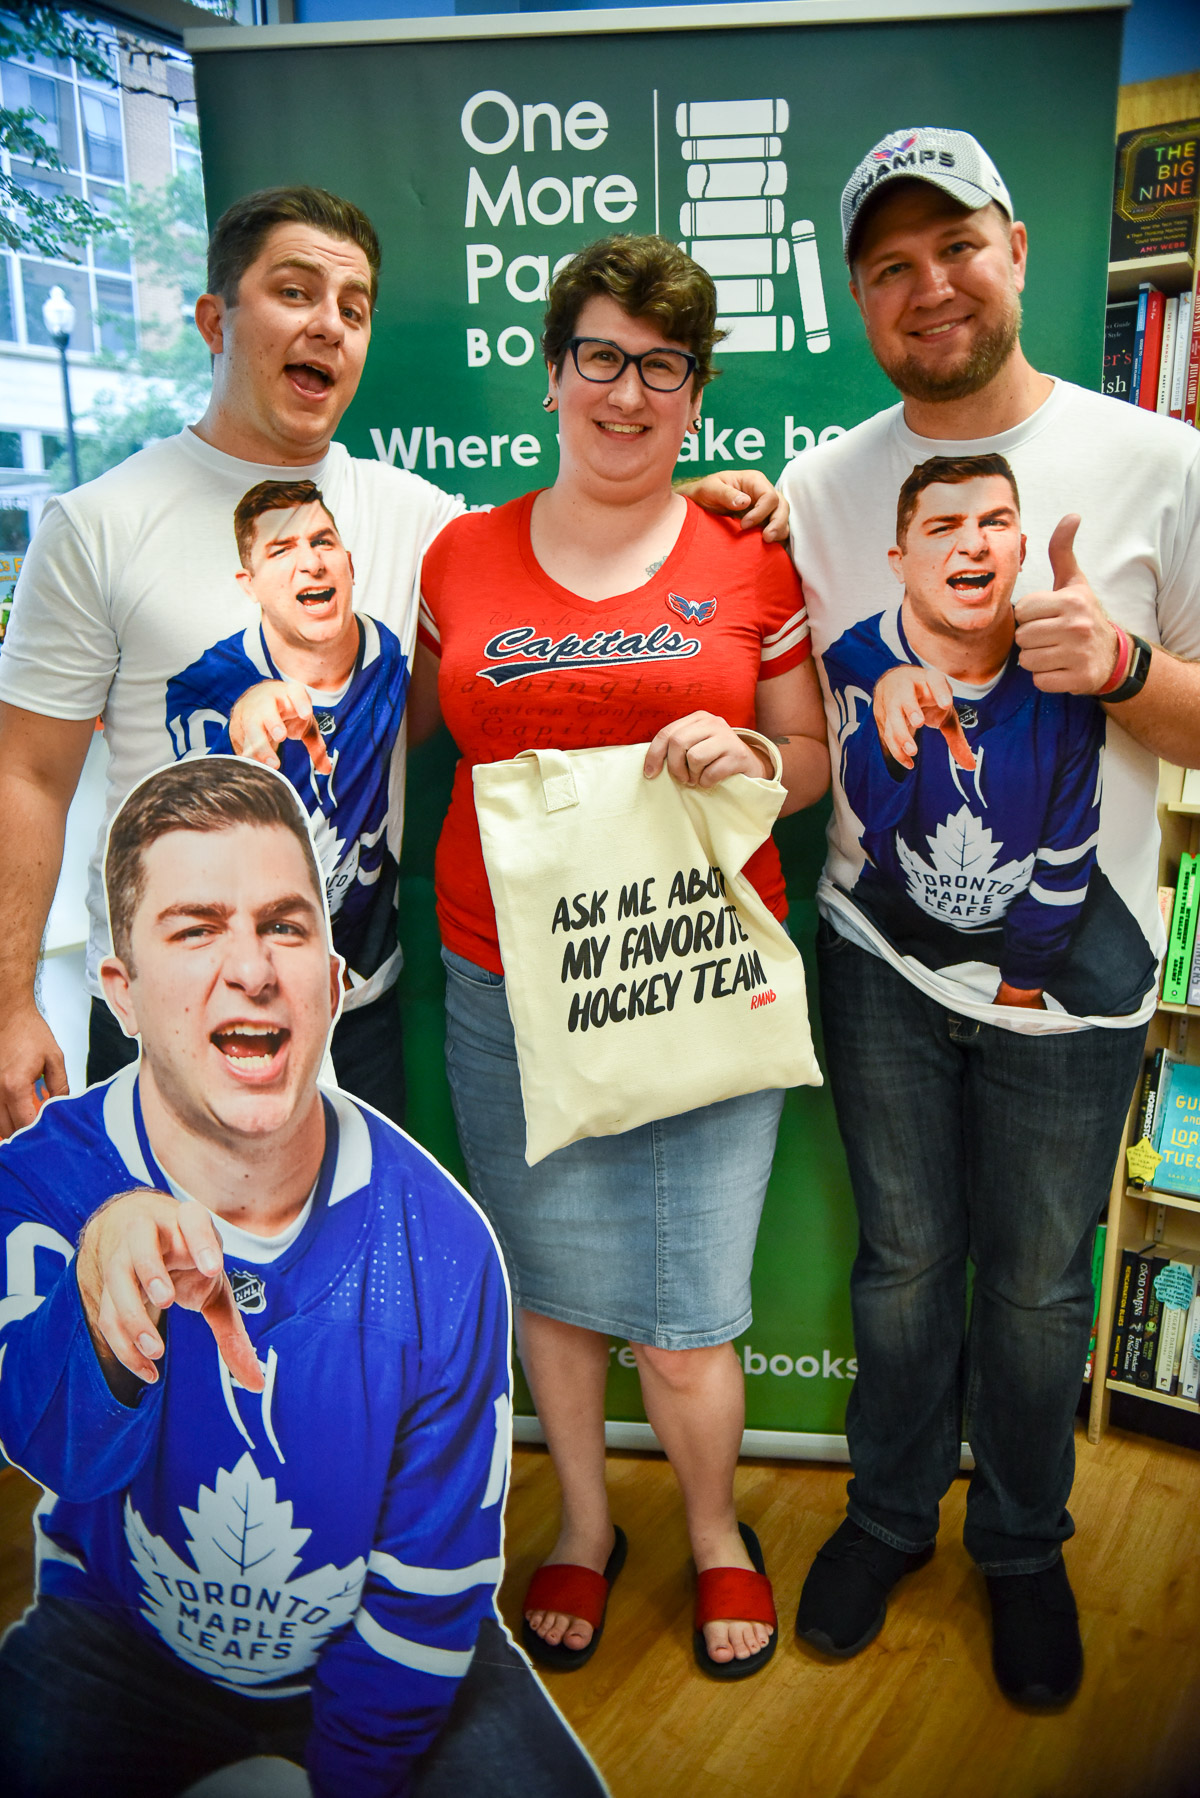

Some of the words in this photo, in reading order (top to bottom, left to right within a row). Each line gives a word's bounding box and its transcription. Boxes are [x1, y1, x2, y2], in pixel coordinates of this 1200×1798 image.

[461, 90, 608, 154] One
[1155, 141, 1196, 162] THE
[1158, 160, 1195, 180] BIG
[465, 165, 637, 228] More
[1140, 179, 1192, 201] NINE
[1140, 245, 1158, 253] AMY
[466, 326, 534, 367] BO
[1101, 375, 1127, 394] ish
[369, 426, 541, 469] Where
[677, 418, 766, 461] ake
[484, 624, 700, 665] Capitals
[911, 869, 1015, 895] TORONTO
[925, 885, 995, 905] MAPLE
[551, 889, 608, 934] ASK
[617, 877, 656, 922] ME
[925, 895, 991, 916] LEAFS
[561, 934, 611, 983] MY
[567, 969, 683, 1033] HOCKEY
[690, 949, 768, 1004] TEAM
[750, 989, 777, 1010] RMND
[1170, 1128, 1199, 1148] LOR
[1138, 1263, 1148, 1287] GOOD
[235, 1283, 257, 1302] NHL
[744, 1345, 859, 1380] books
[152, 1570, 331, 1625] TORONTO
[179, 1601, 298, 1639] MAPLE
[178, 1619, 292, 1660] LEAFS
